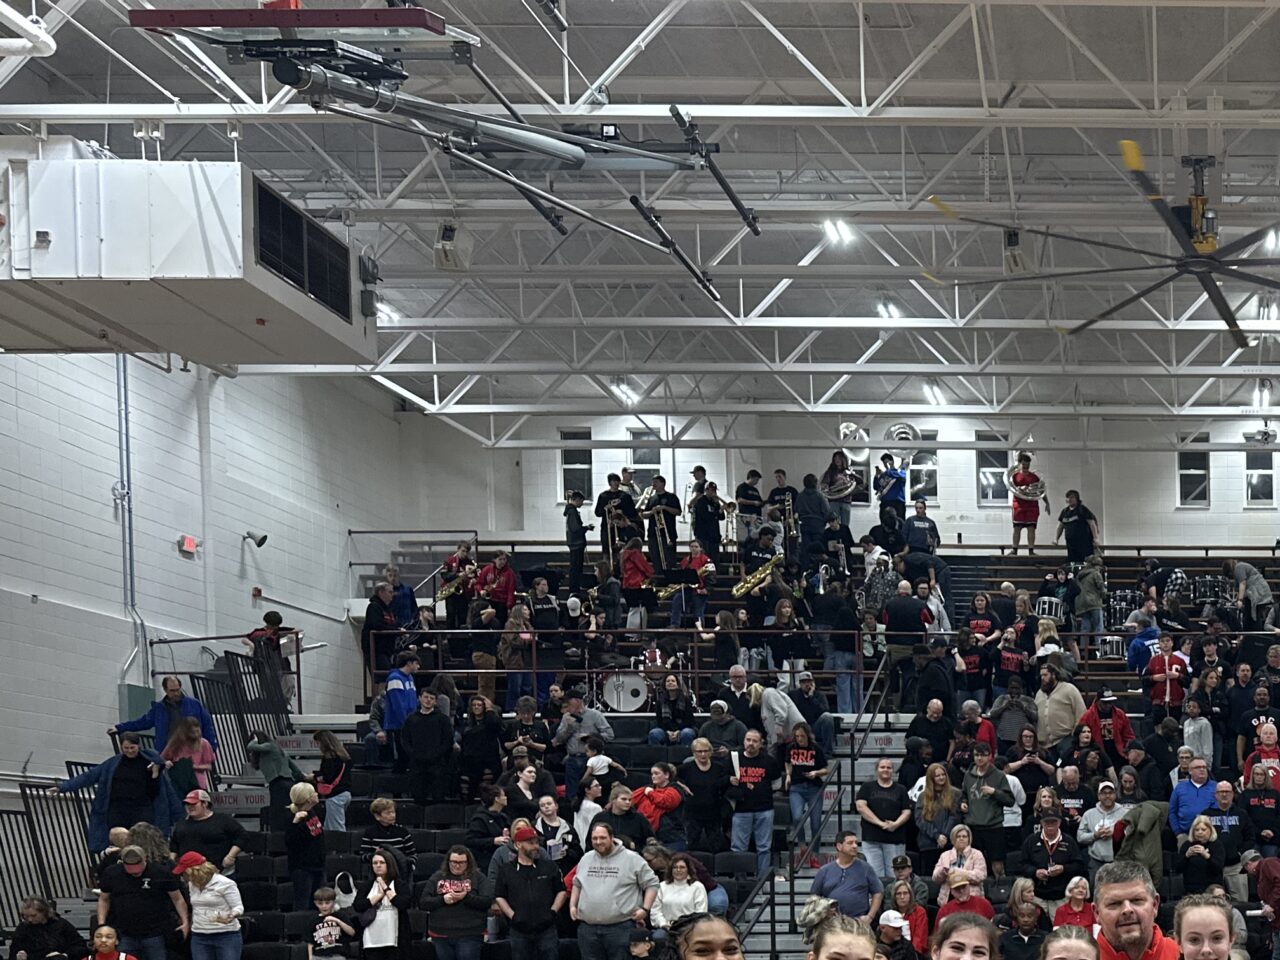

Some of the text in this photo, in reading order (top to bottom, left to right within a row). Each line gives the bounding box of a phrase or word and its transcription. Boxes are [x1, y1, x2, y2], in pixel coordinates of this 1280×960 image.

[1251, 715, 1276, 727] GRC
[873, 737, 893, 747] YOUR
[790, 749, 816, 764] GRC
[244, 794, 265, 805] YOUR
